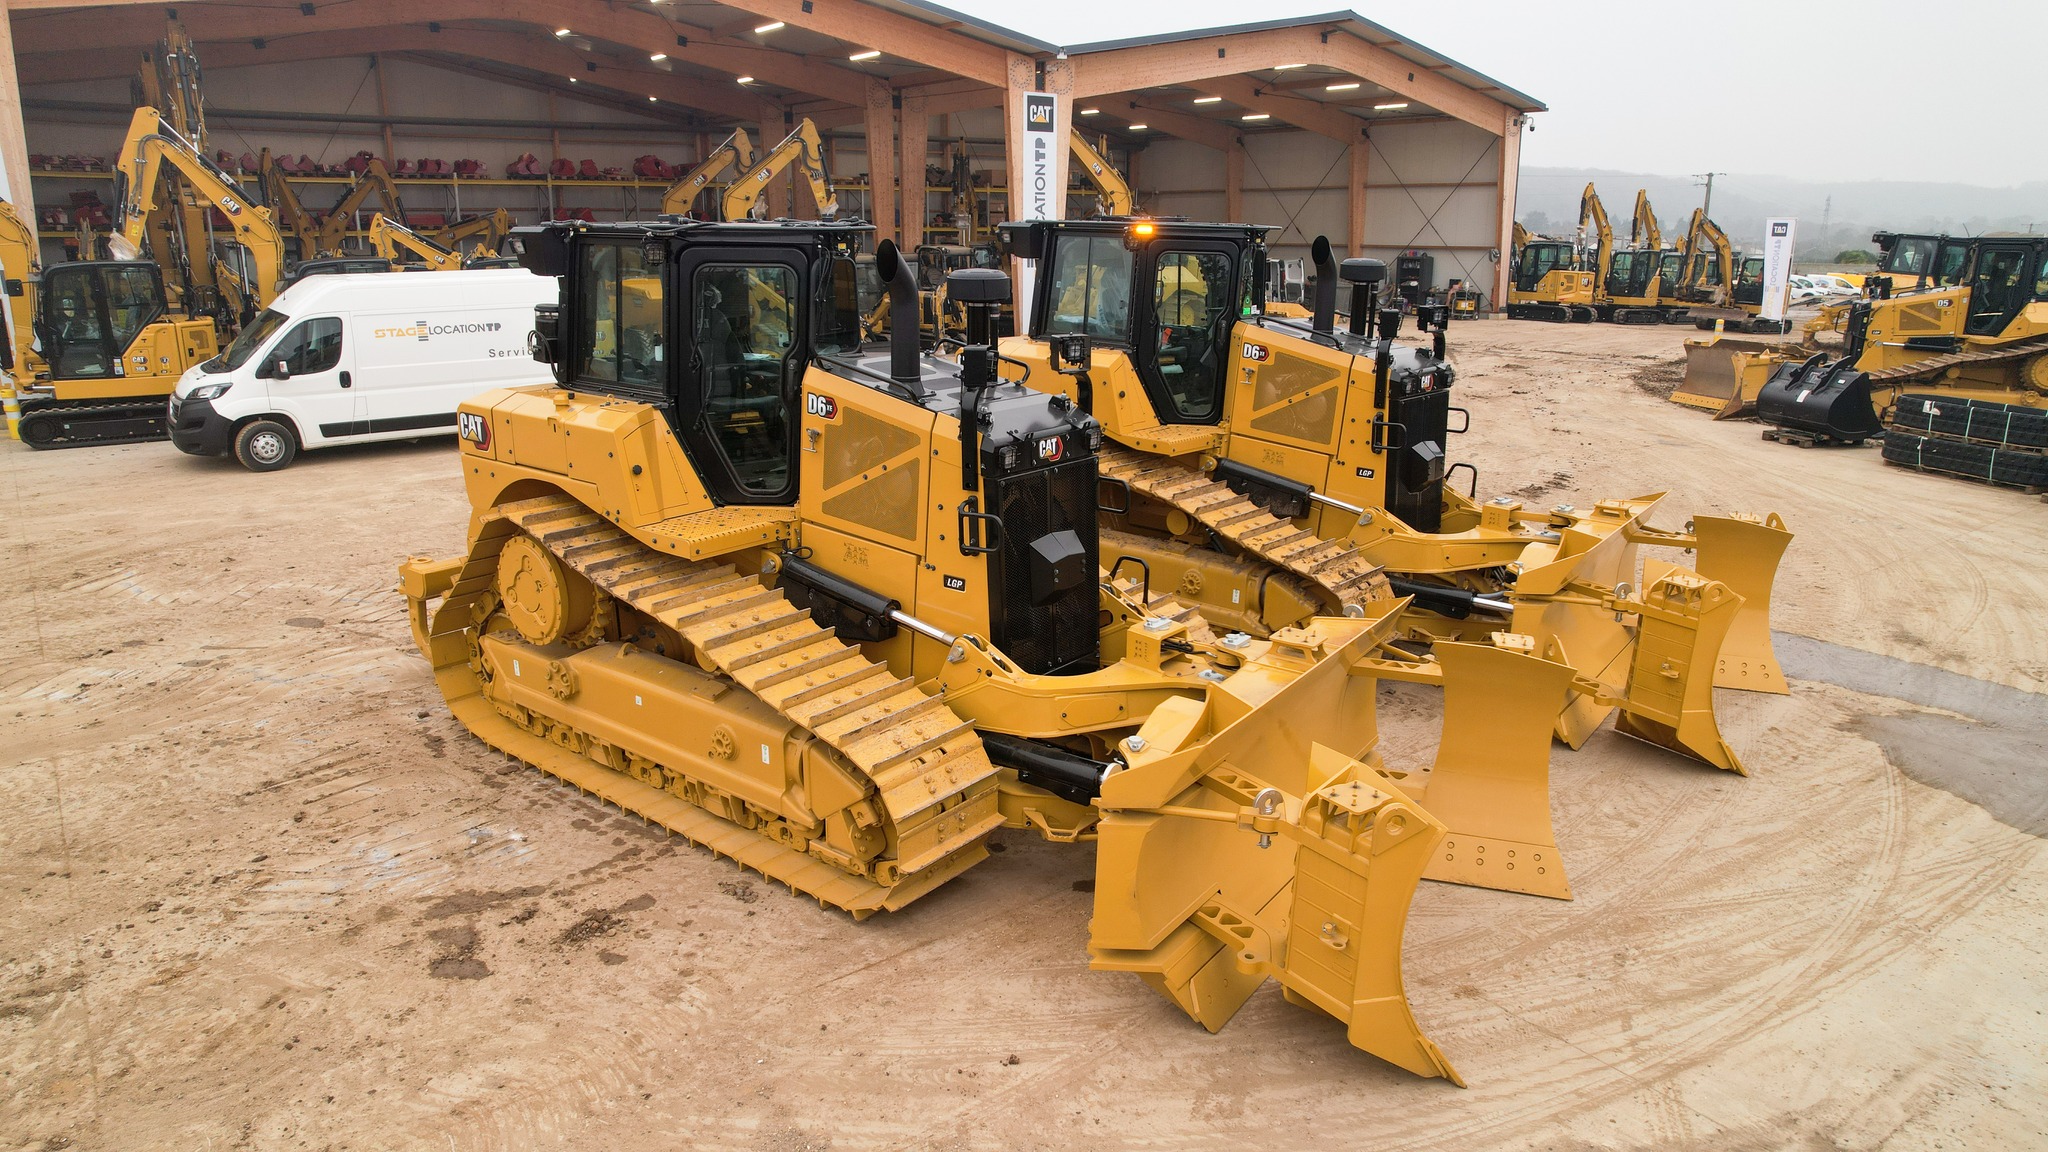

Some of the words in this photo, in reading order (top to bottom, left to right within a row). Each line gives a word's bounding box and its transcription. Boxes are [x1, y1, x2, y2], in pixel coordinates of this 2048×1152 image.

[1030, 105, 1053, 122] CAT
[1092, 162, 1102, 174] CAT
[694, 174, 705, 186] CAT
[757, 169, 769, 182] CAT
[221, 196, 240, 212] CAT
[434, 255, 444, 263] CAT
[1243, 343, 1259, 360] D6
[1421, 375, 1430, 388] CAT
[807, 393, 826, 416] D6
[460, 412, 484, 442] CAT
[1040, 438, 1057, 457] CAT
[1359, 469, 1372, 477] LGP
[946, 579, 963, 589] LGP
